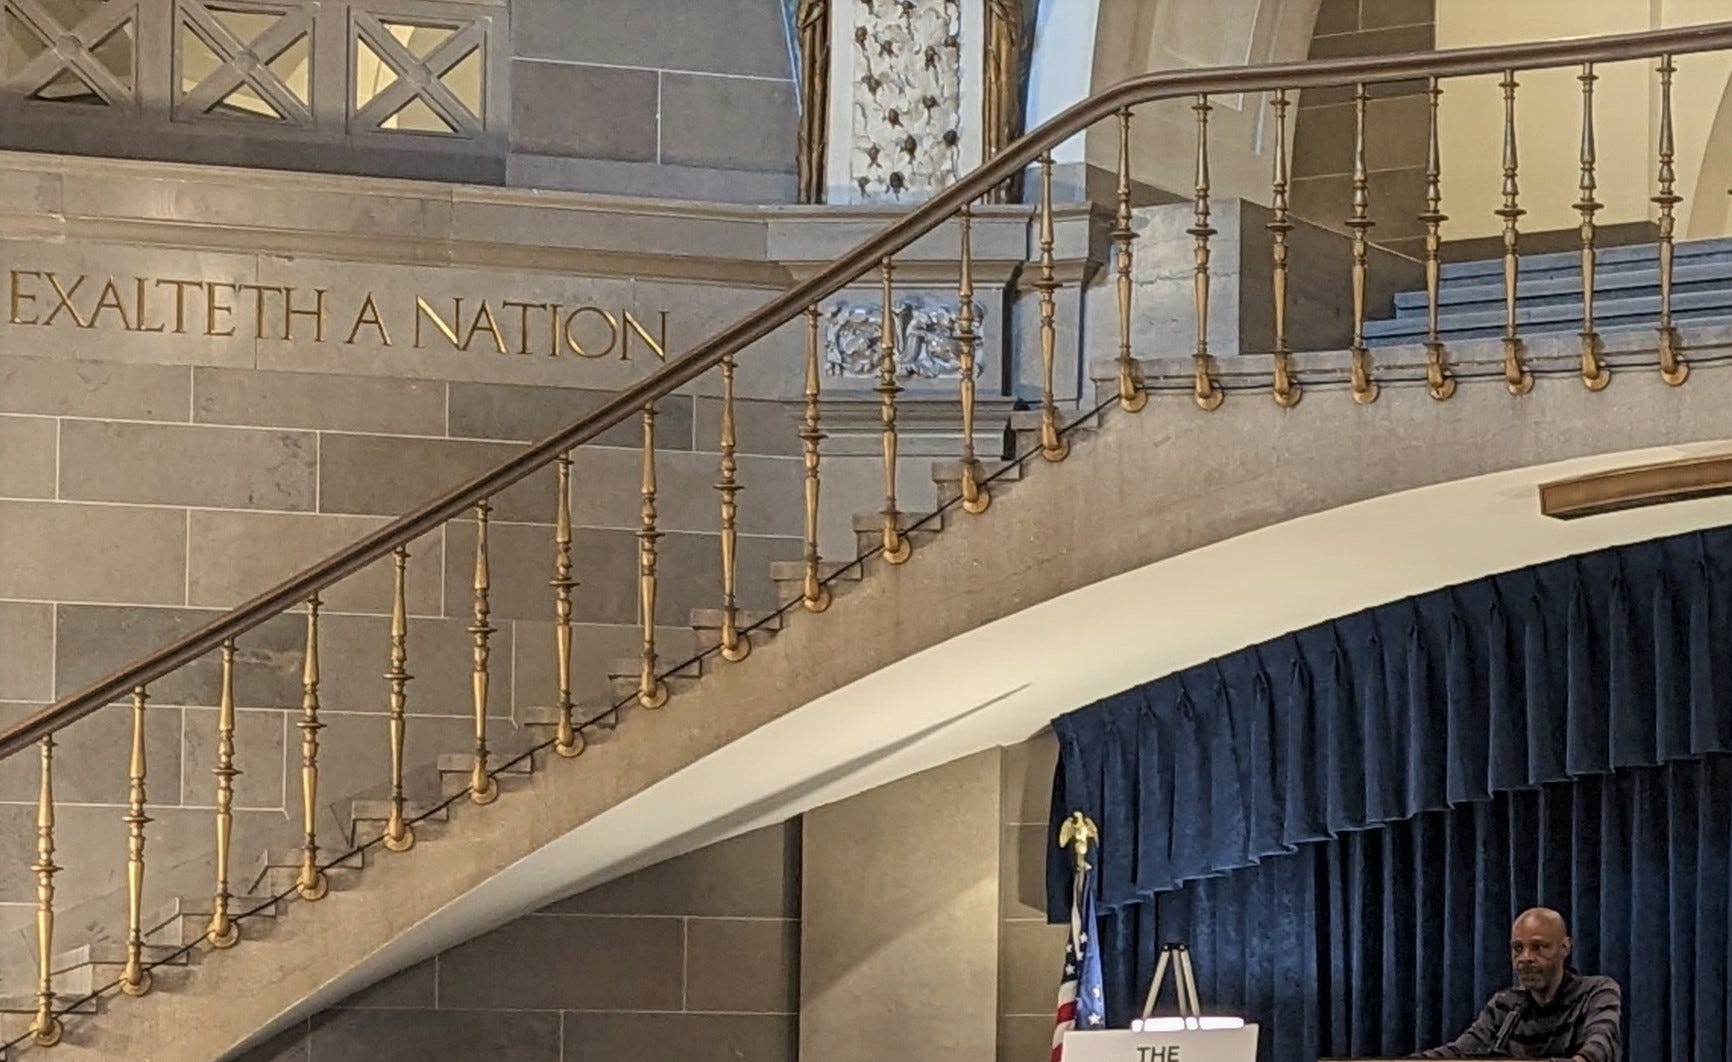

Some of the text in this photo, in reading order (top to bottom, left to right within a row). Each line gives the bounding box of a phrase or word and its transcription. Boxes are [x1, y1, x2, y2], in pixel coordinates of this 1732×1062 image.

[9, 269, 669, 363] EXALTETH A NATION
